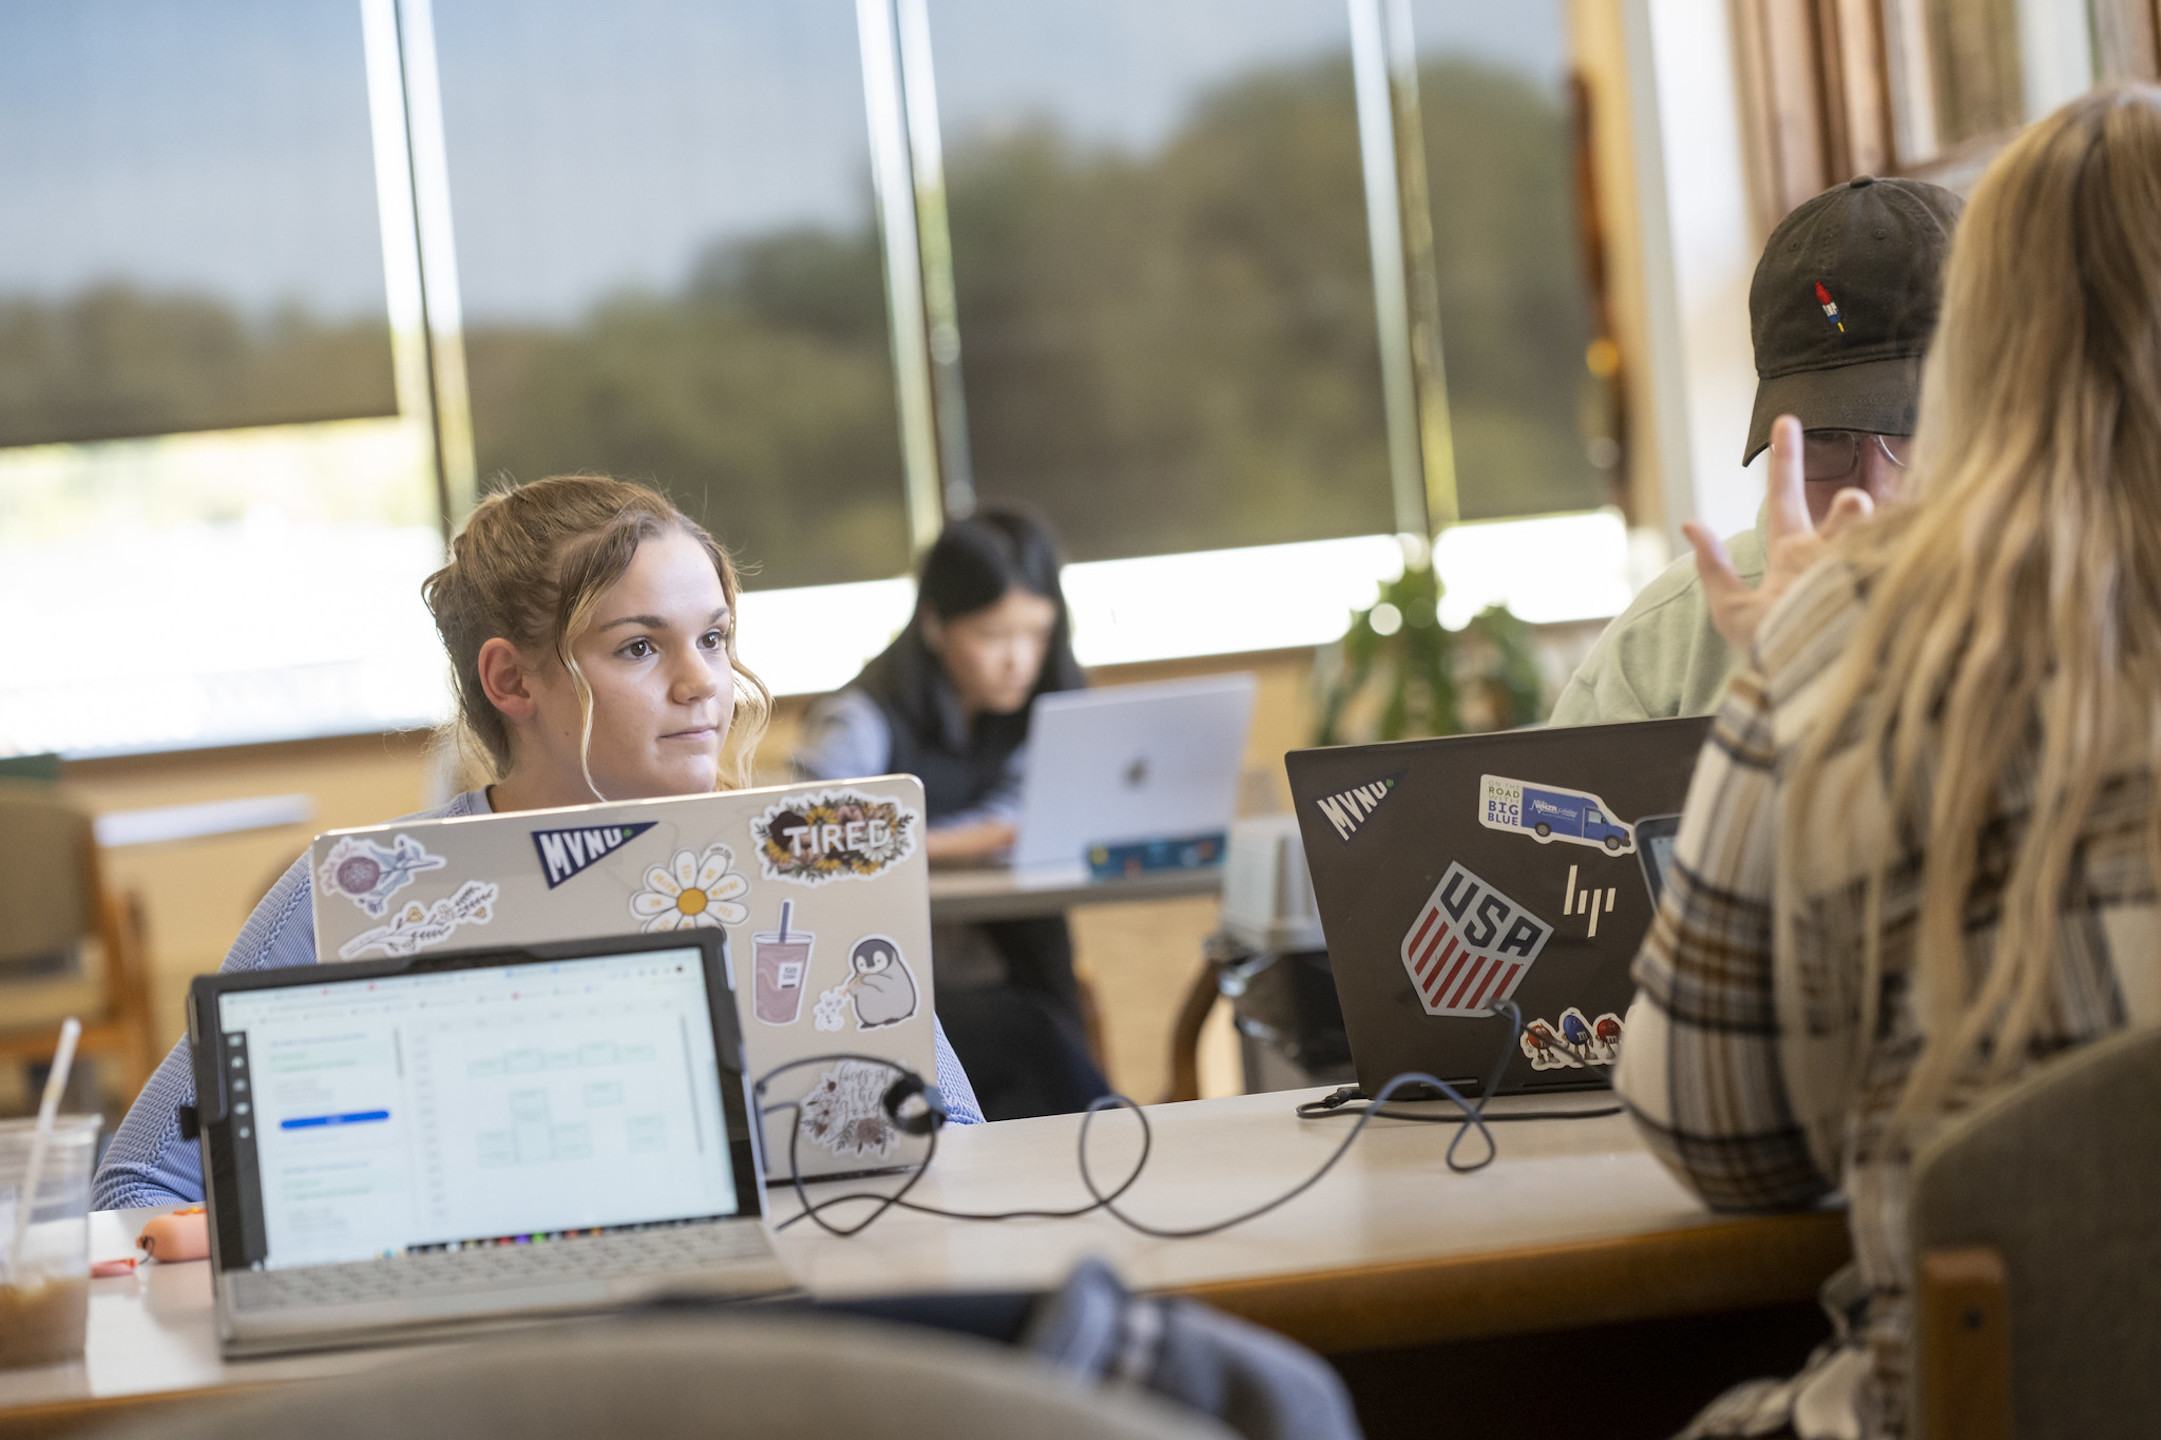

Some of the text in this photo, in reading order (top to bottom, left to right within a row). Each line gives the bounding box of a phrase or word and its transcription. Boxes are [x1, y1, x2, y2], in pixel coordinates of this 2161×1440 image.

[1488, 794, 1519, 804] WITH
[1489, 787, 1520, 799] ROAD
[1317, 781, 1388, 841] MVNU
[1488, 812, 1518, 826] BLUE
[1489, 800, 1518, 816] BIG
[783, 819, 890, 857] TIRED
[539, 827, 623, 883] MVNU
[1440, 871, 1543, 957] USA
